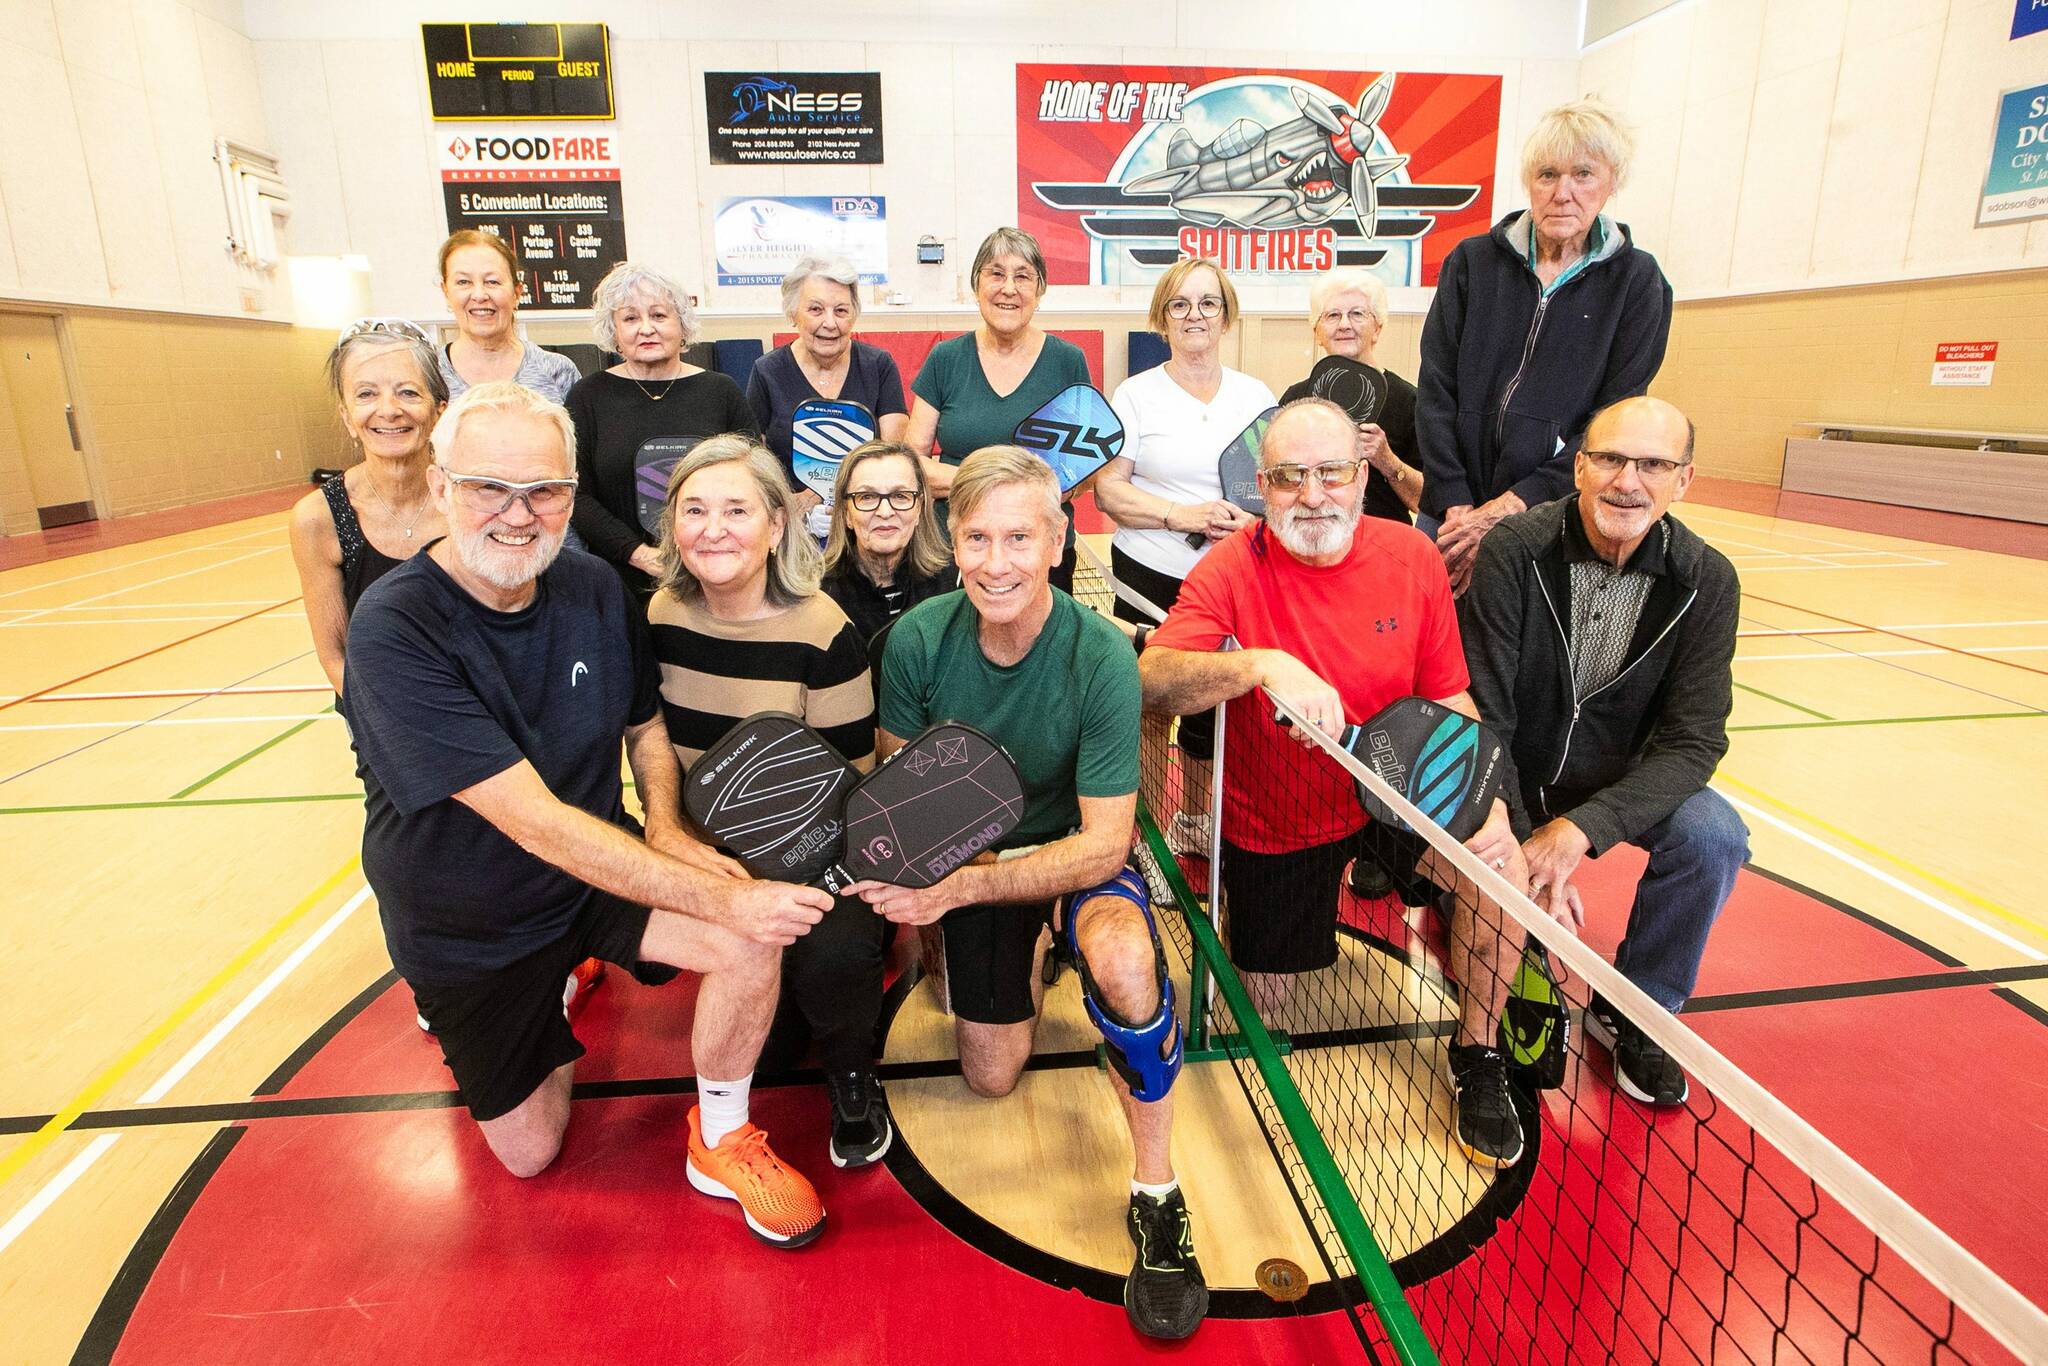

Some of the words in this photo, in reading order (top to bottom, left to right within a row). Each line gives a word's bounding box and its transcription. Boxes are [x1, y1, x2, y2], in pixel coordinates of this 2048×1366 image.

[436, 62, 476, 77] HOME
[501, 70, 534, 81] PERIOD
[557, 62, 600, 77] GUEST
[767, 92, 863, 112] NESS
[1039, 79, 1109, 121] HOME
[1107, 82, 1143, 122] OF
[1142, 82, 1189, 123] THE
[768, 113, 801, 122] Auto
[808, 113, 861, 123] Service
[718, 127, 732, 135] One
[733, 127, 748, 136] stop
[749, 127, 769, 136] repair
[770, 127, 787, 136] shop
[788, 127, 797, 135] for
[798, 127, 807, 135] all
[807, 128, 822, 136] your
[823, 127, 846, 136] quality
[738, 149, 856, 160] www.nessautoservice.ca
[2011, 153, 2041, 169] City
[451, 171, 517, 179] EXPECT
[527, 171, 558, 179] THE
[569, 171, 612, 179] BEST
[460, 193, 469, 210] 5
[473, 193, 542, 210] Convenient
[544, 193, 608, 210] Locations:
[529, 224, 545, 236] 905
[577, 224, 593, 236] 839
[523, 236, 553, 249] Portage
[570, 236, 602, 247] Cavalier
[525, 248, 553, 259] Avenue
[576, 248, 598, 258] Drive
[1178, 226, 1337, 274] SPITFIRES
[553, 270, 569, 281] 115
[543, 282, 580, 295] Maryland
[551, 293, 575, 304] Street
[1012, 418, 1124, 461] SLK
[714, 733, 760, 773] SELKIRK
[781, 826, 826, 868] epic
[928, 822, 1004, 878] DIAMOND
